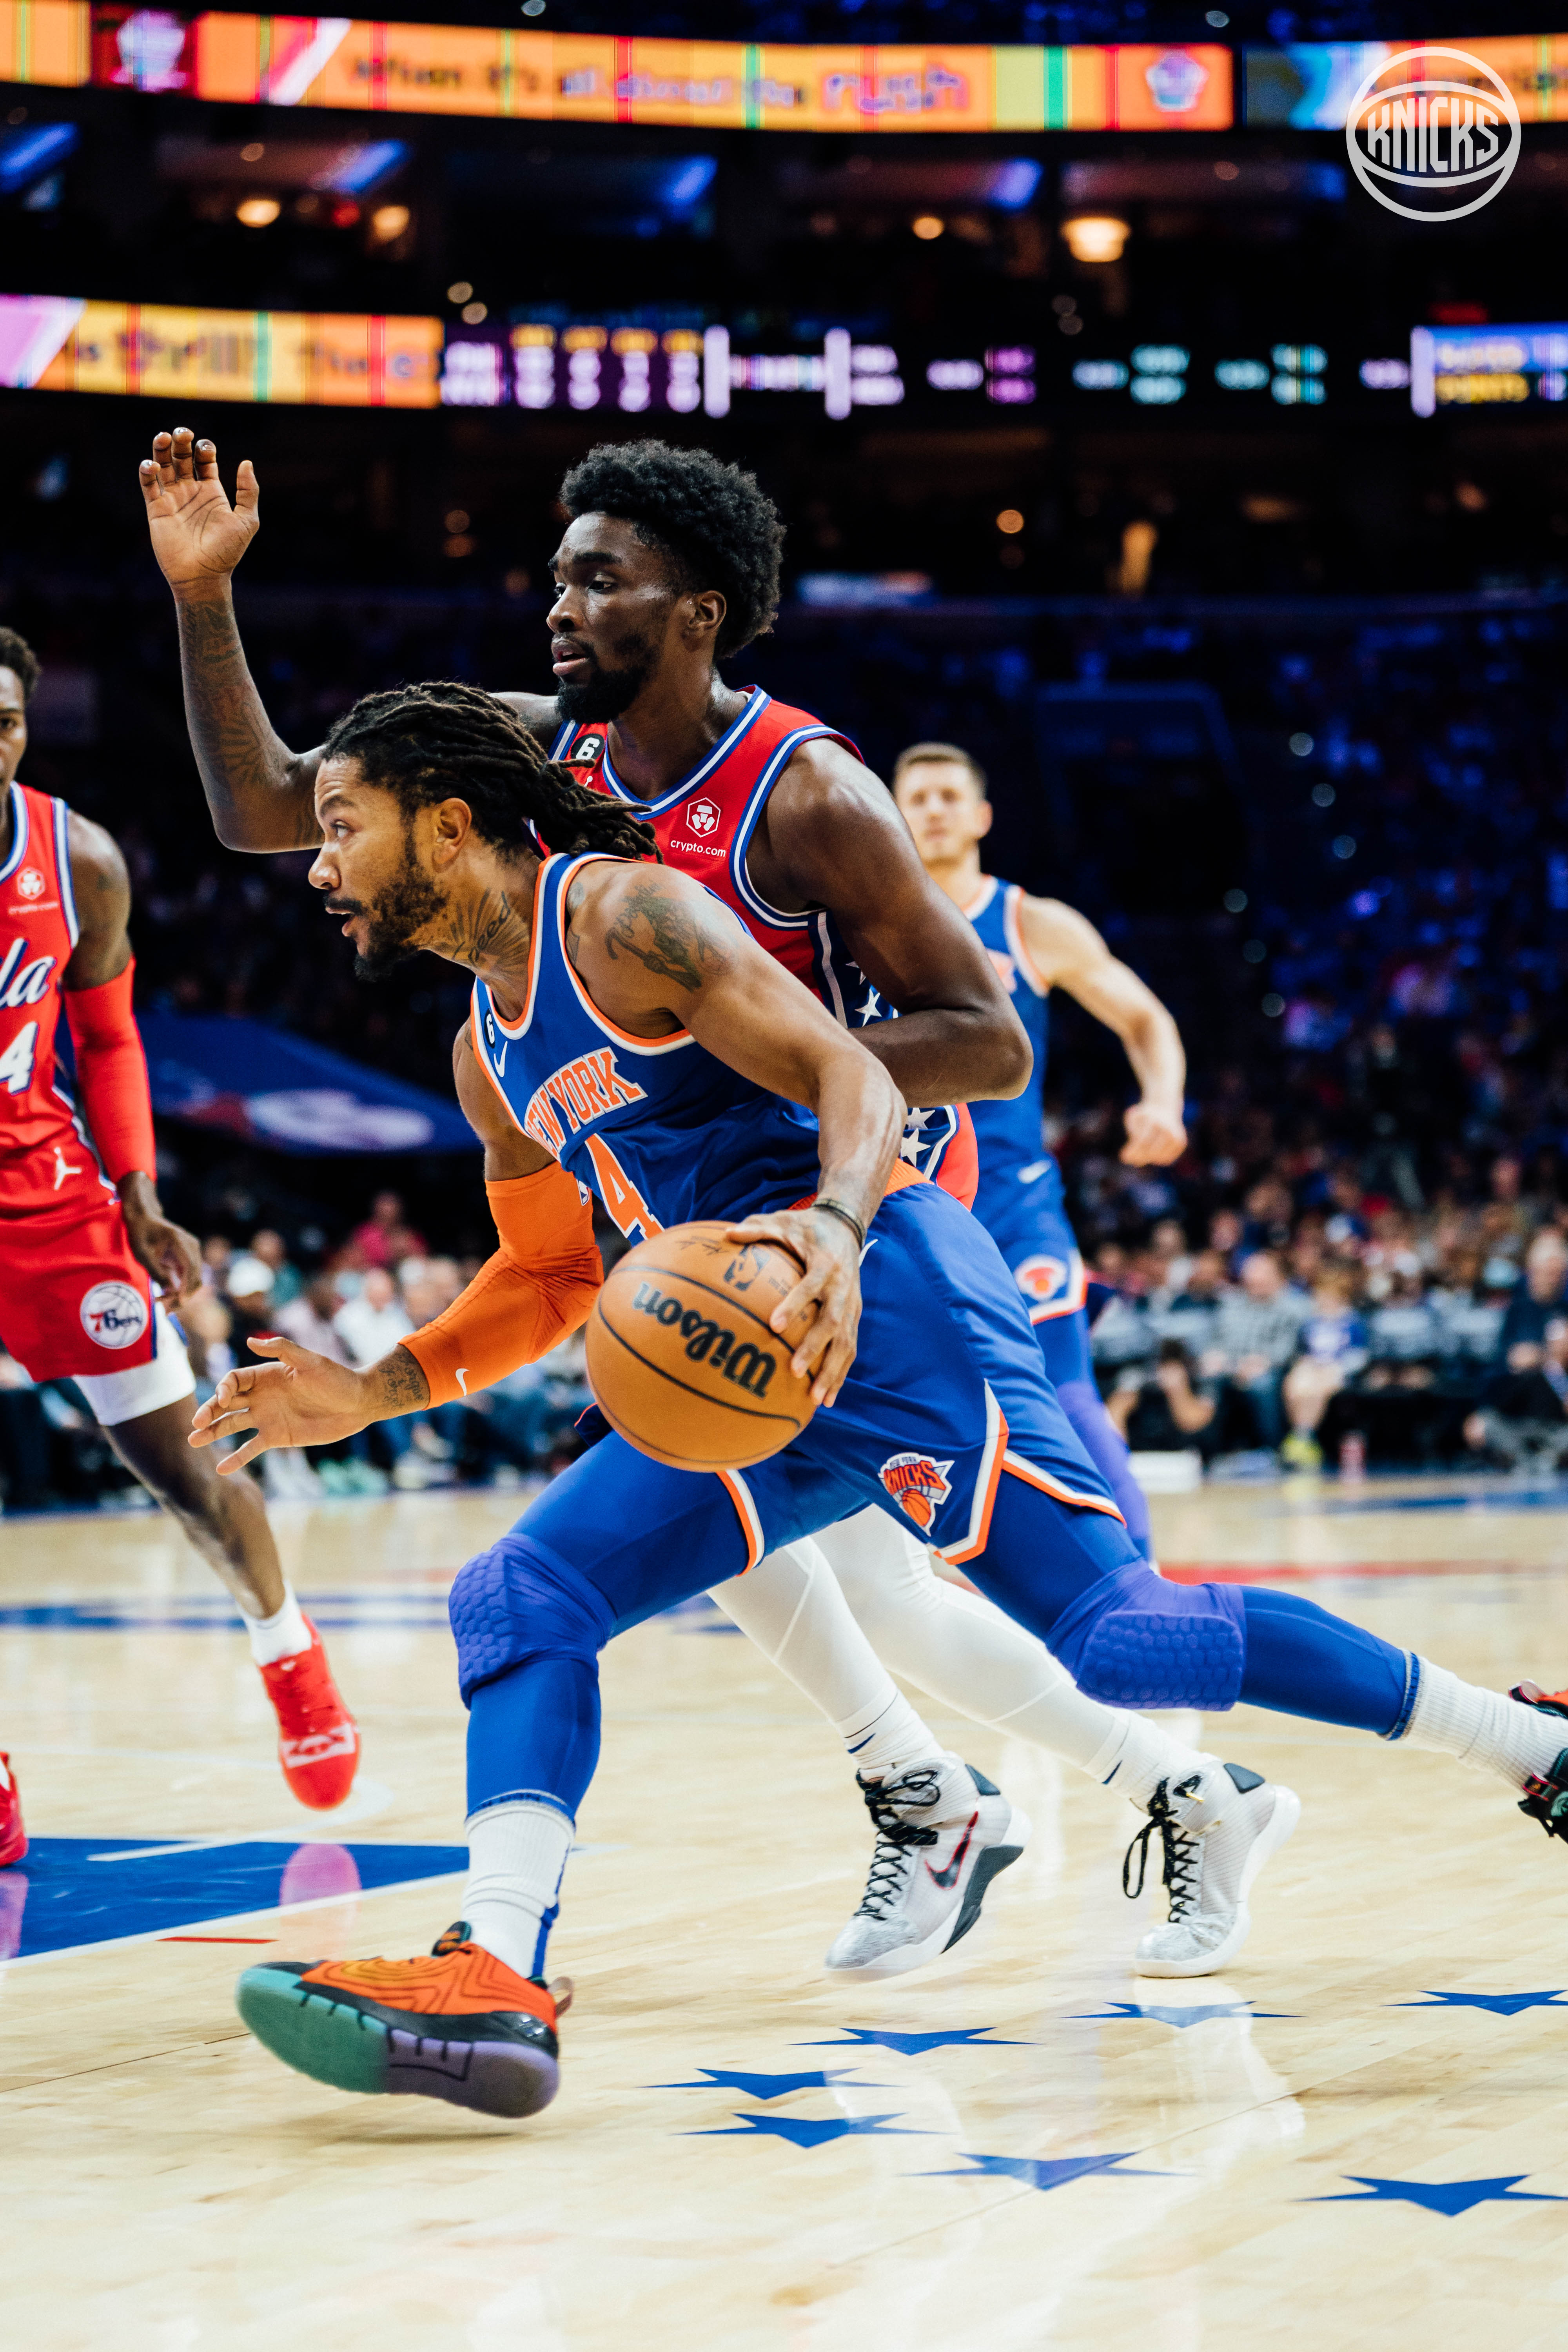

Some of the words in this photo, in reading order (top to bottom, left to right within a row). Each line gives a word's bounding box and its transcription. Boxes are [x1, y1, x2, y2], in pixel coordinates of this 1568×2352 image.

[576, 737, 600, 760] 6
[670, 840, 726, 858] crypto.com
[486, 1013, 495, 1044] 6
[544, 1046, 648, 1135] YORK
[584, 1132, 666, 1240] 4
[632, 1281, 777, 1401] Wilson
[884, 1460, 946, 1495] KNICKS
